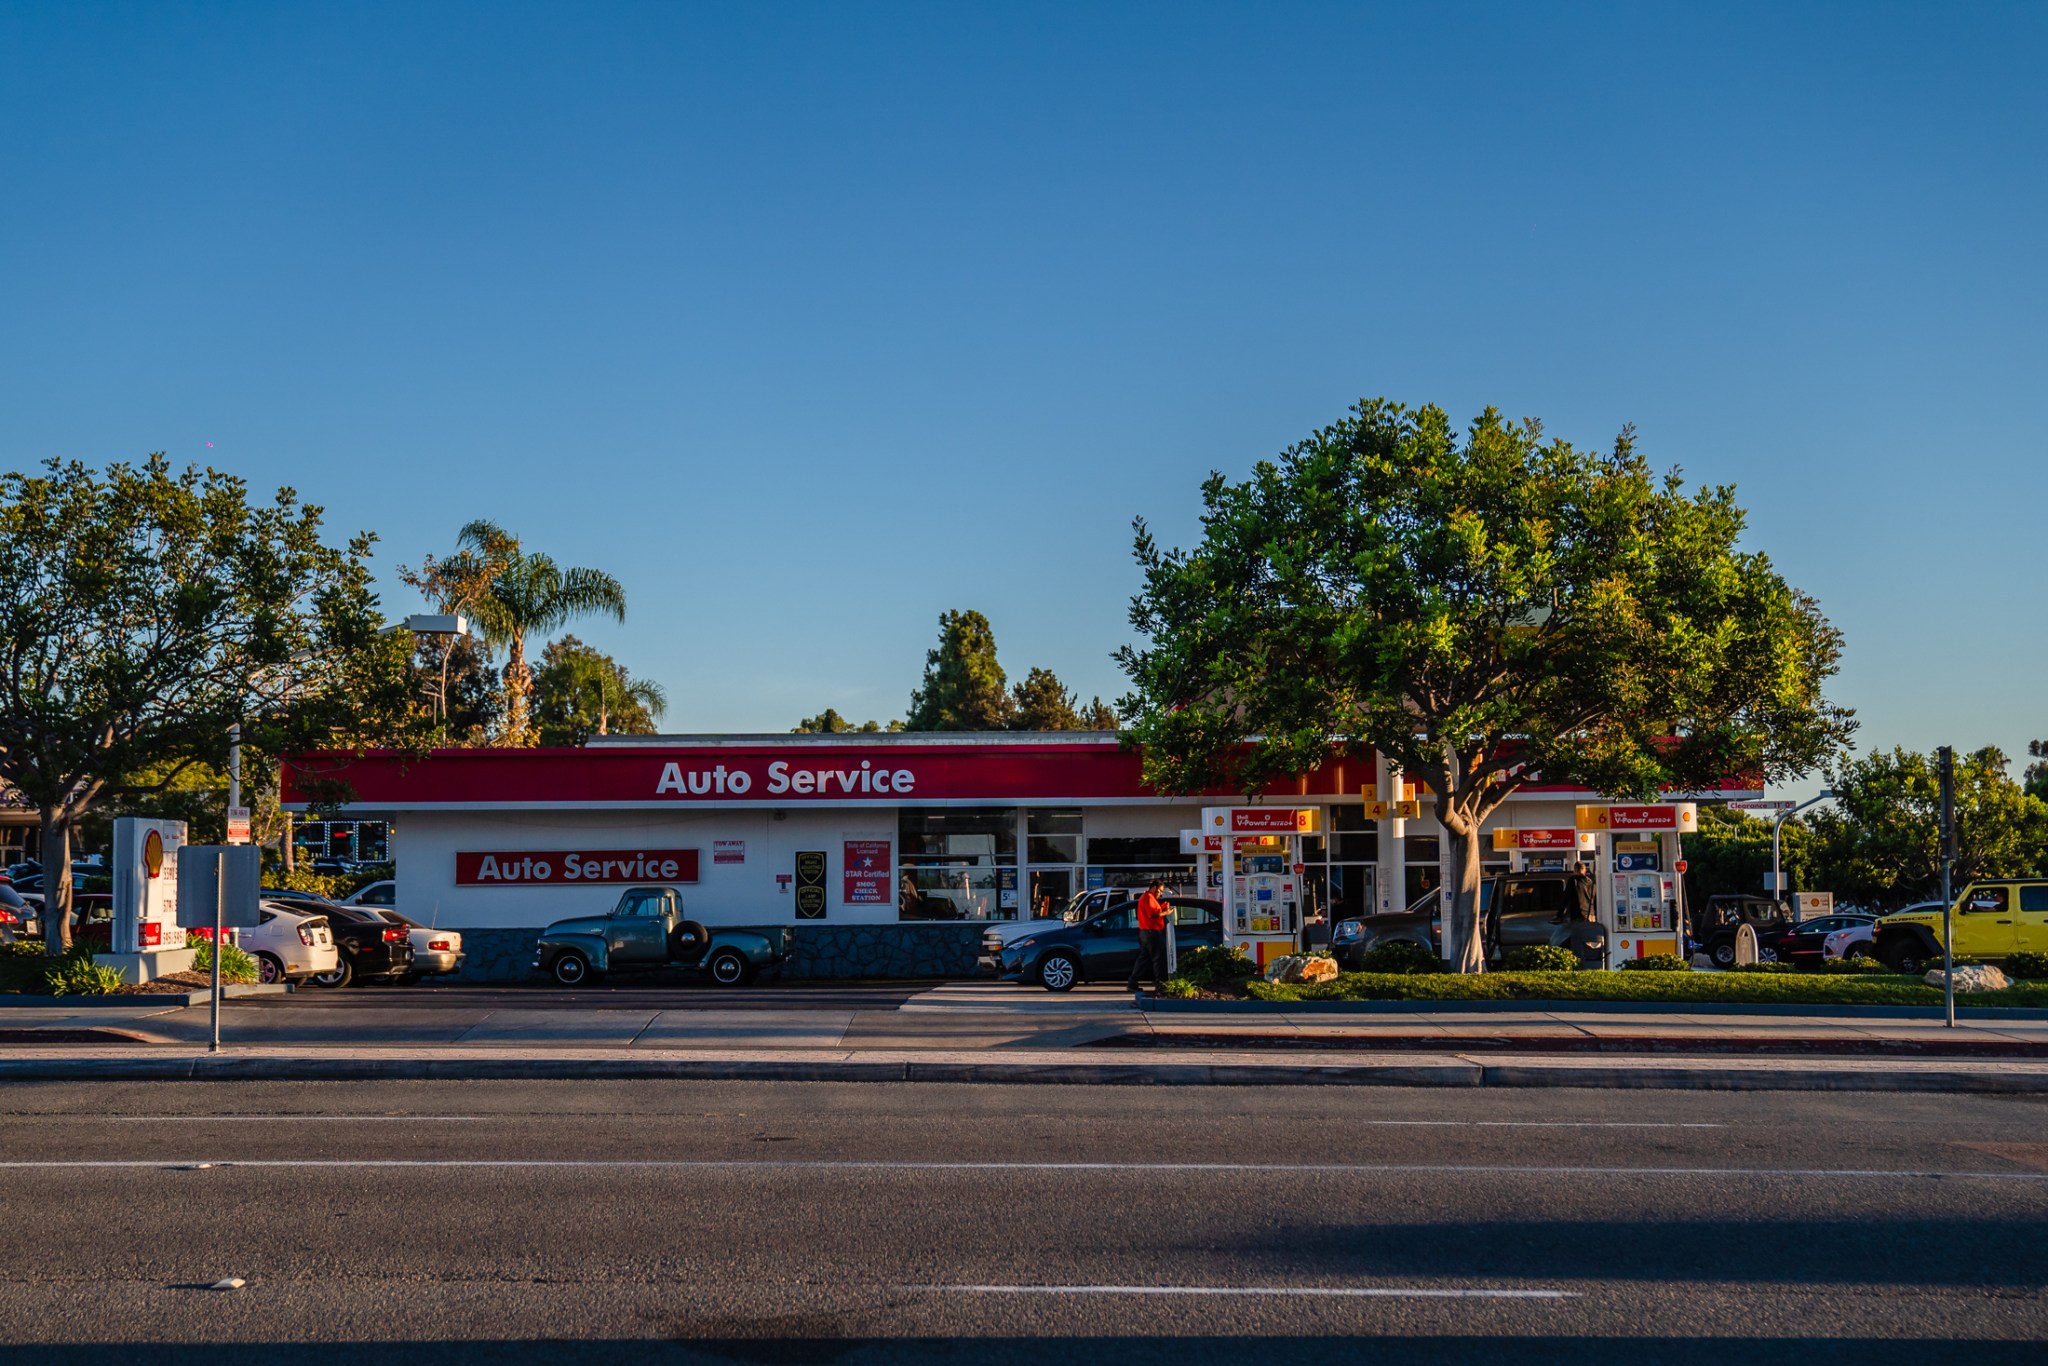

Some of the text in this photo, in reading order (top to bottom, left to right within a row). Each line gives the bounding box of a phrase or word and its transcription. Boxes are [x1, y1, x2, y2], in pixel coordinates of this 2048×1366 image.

[656, 760, 915, 794] Auto Service
[1372, 805, 1381, 815] 4
[1402, 804, 1410, 815] 2
[1299, 815, 1306, 826] 8
[1598, 813, 1607, 824] 6
[1261, 837, 1268, 846] 4
[1511, 833, 1518, 844] 2
[477, 853, 679, 880] Auto Service
[845, 870, 890, 878] STAR Certified
